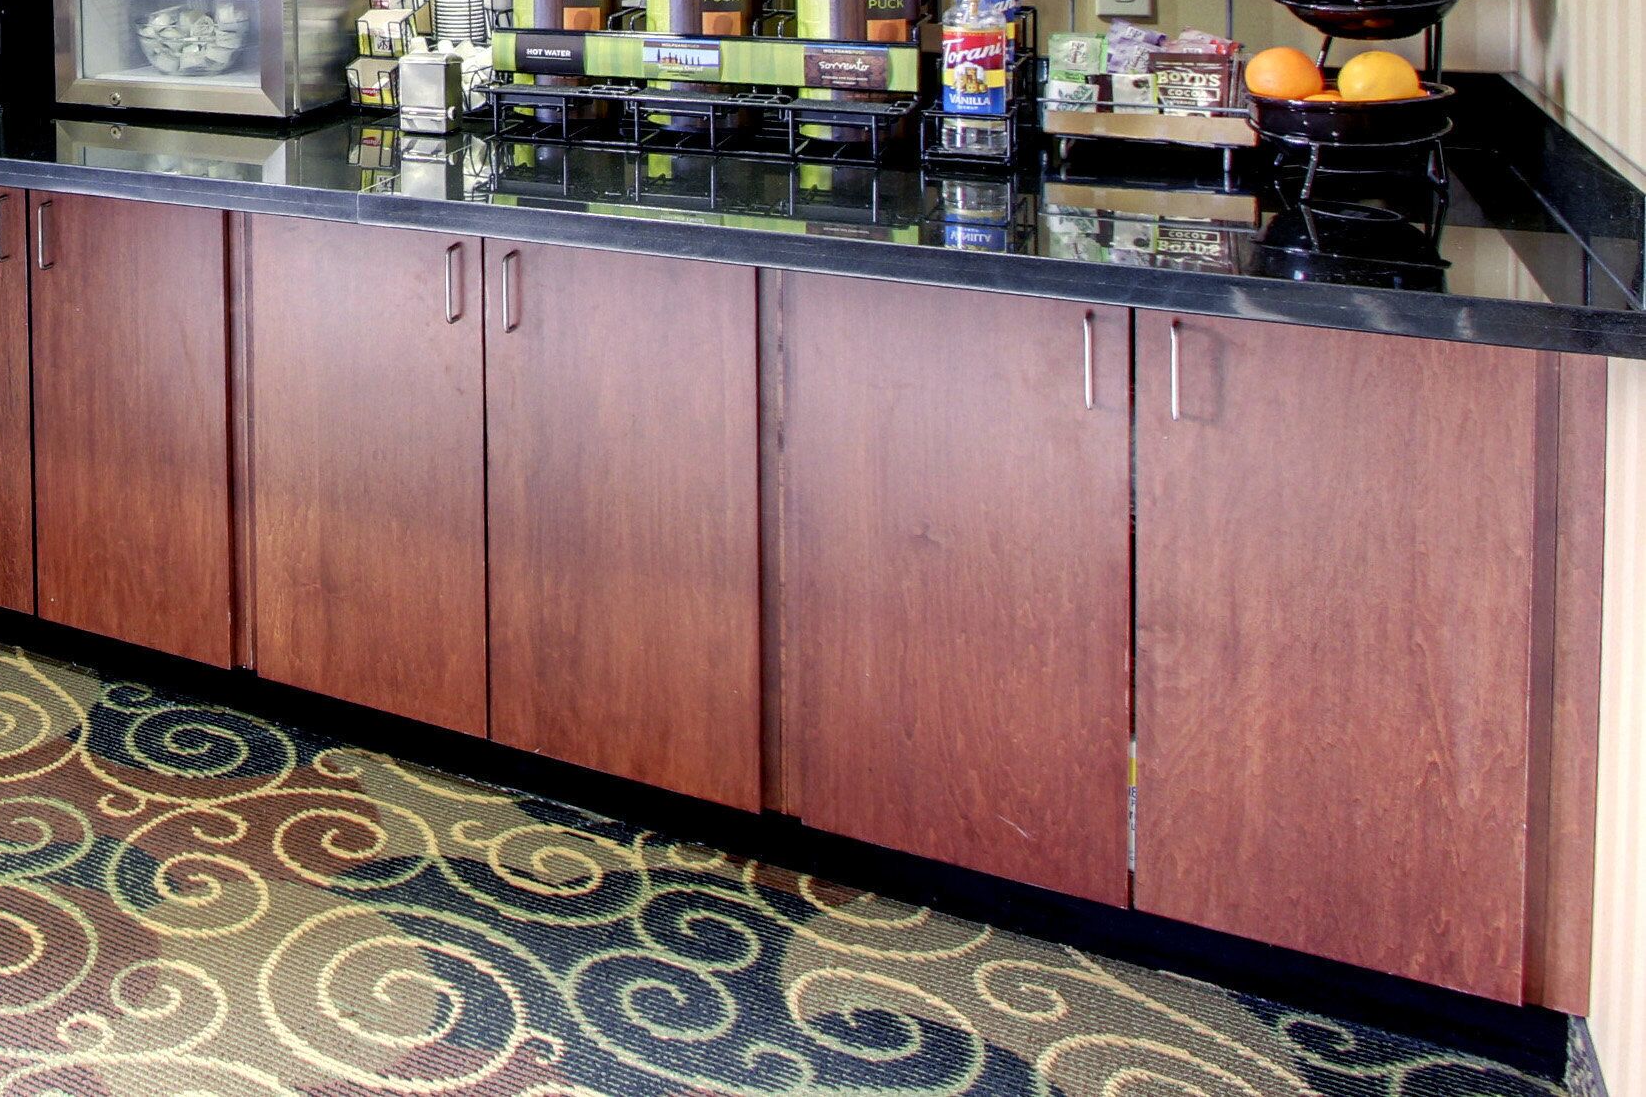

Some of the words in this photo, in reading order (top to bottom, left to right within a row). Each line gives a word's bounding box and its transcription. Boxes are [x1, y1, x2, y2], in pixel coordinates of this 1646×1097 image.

[526, 48, 543, 56] HOT
[544, 49, 571, 57] WATER
[942, 37, 1002, 67] Torani
[1155, 71, 1222, 87] BOYD'S
[948, 92, 991, 106] VANILLA
